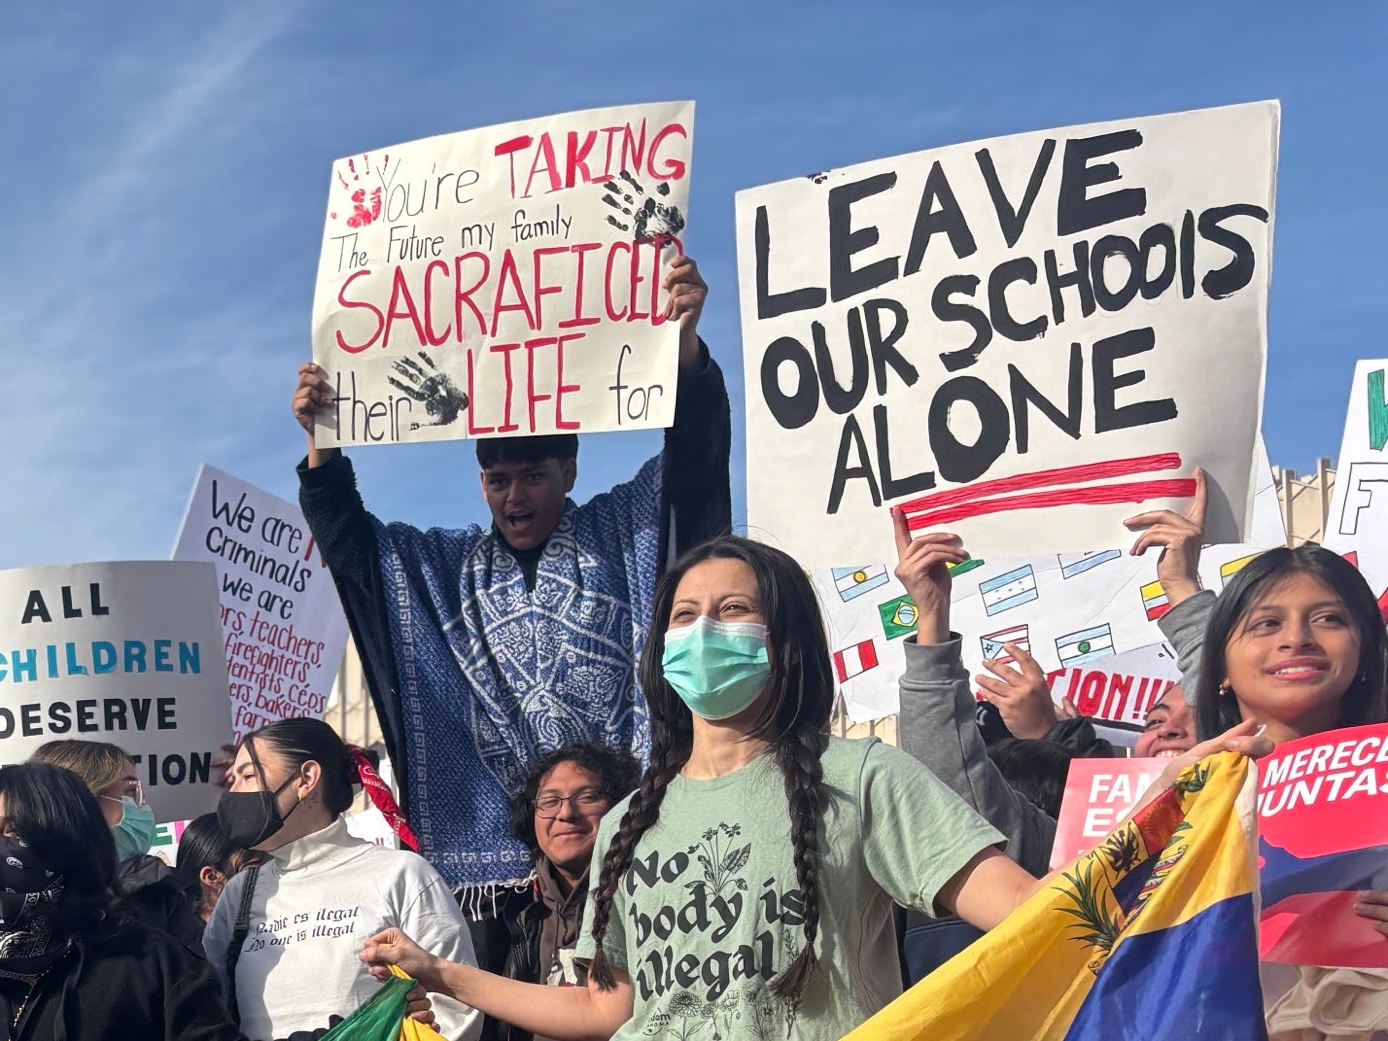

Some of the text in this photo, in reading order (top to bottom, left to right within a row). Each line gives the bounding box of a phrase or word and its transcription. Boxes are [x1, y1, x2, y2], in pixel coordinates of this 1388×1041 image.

[376, 118, 688, 222] You're TAKING
[331, 204, 572, 273] The Future my family
[755, 129, 1146, 319] LEAVE
[332, 333, 663, 441] their LIFE for
[761, 298, 919, 429] OUR
[827, 326, 1177, 514] ALONE
[212, 480, 255, 533] We
[262, 517, 302, 553] are
[21, 583, 109, 624] ALL
[258, 590, 293, 619] are
[626, 850, 689, 896] No
[270, 935, 292, 946] one
[297, 930, 307, 942] is
[312, 922, 355, 938] illegal
[294, 912, 310, 924] es
[316, 906, 359, 922] ilegal
[629, 877, 805, 949] body is
[636, 931, 778, 1002] illegal
